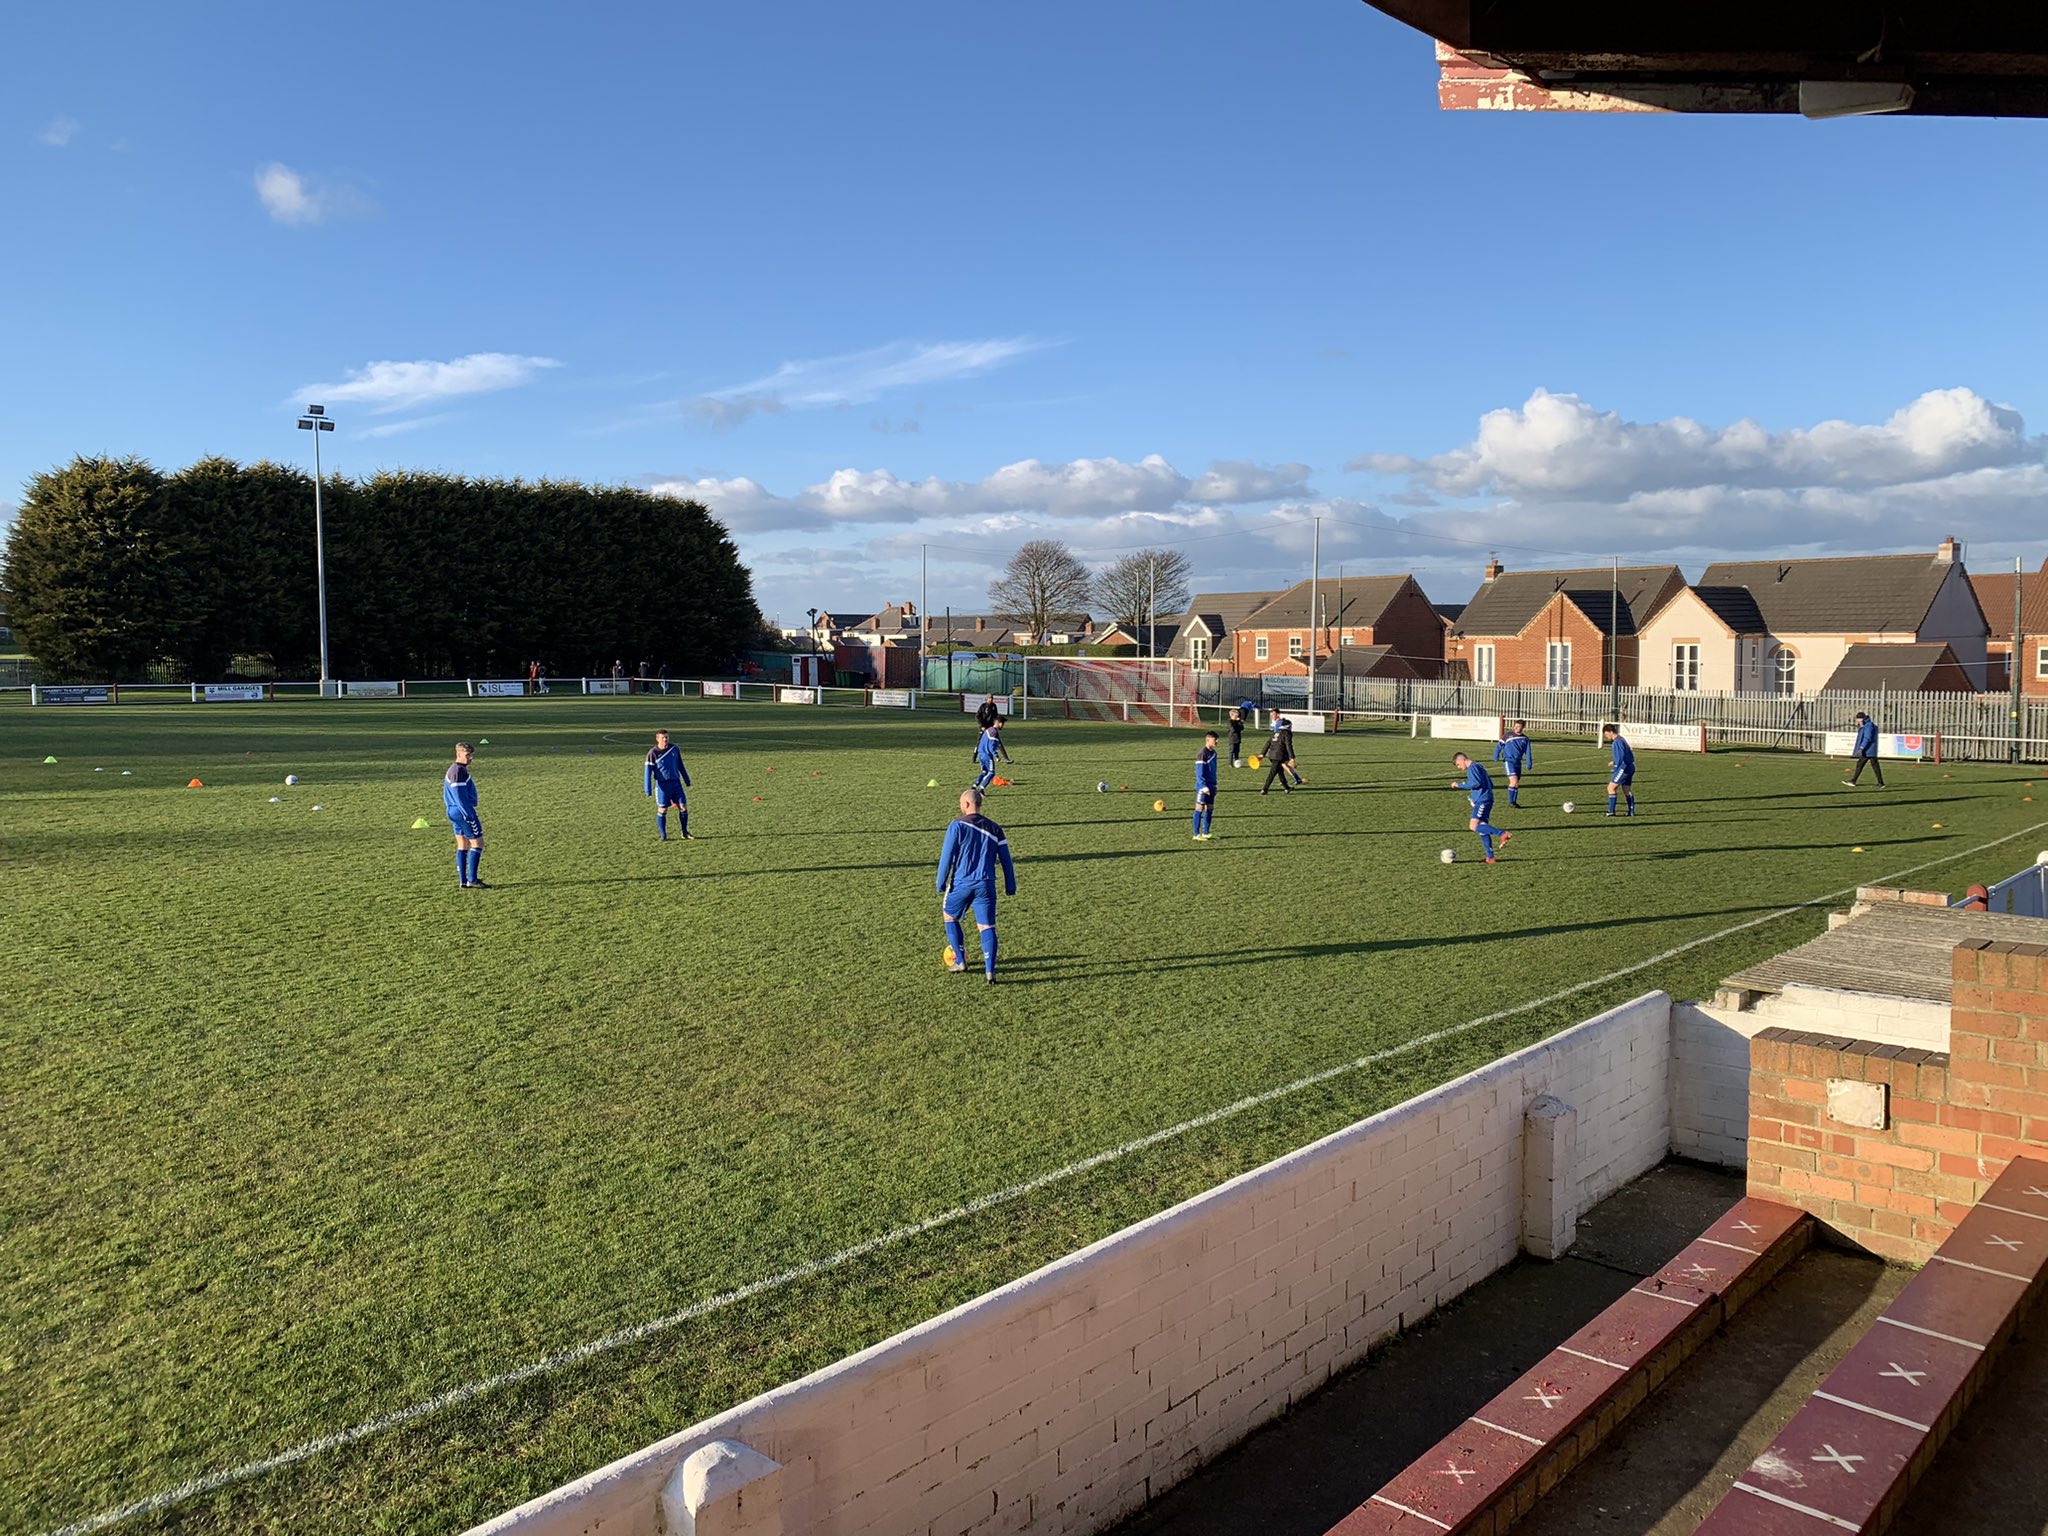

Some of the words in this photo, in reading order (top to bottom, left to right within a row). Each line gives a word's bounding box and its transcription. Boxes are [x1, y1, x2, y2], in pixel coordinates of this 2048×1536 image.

[488, 684, 504, 693] ISL
[1622, 723, 1675, 736] Nor-Dem
[1679, 726, 1700, 737] Ltd
